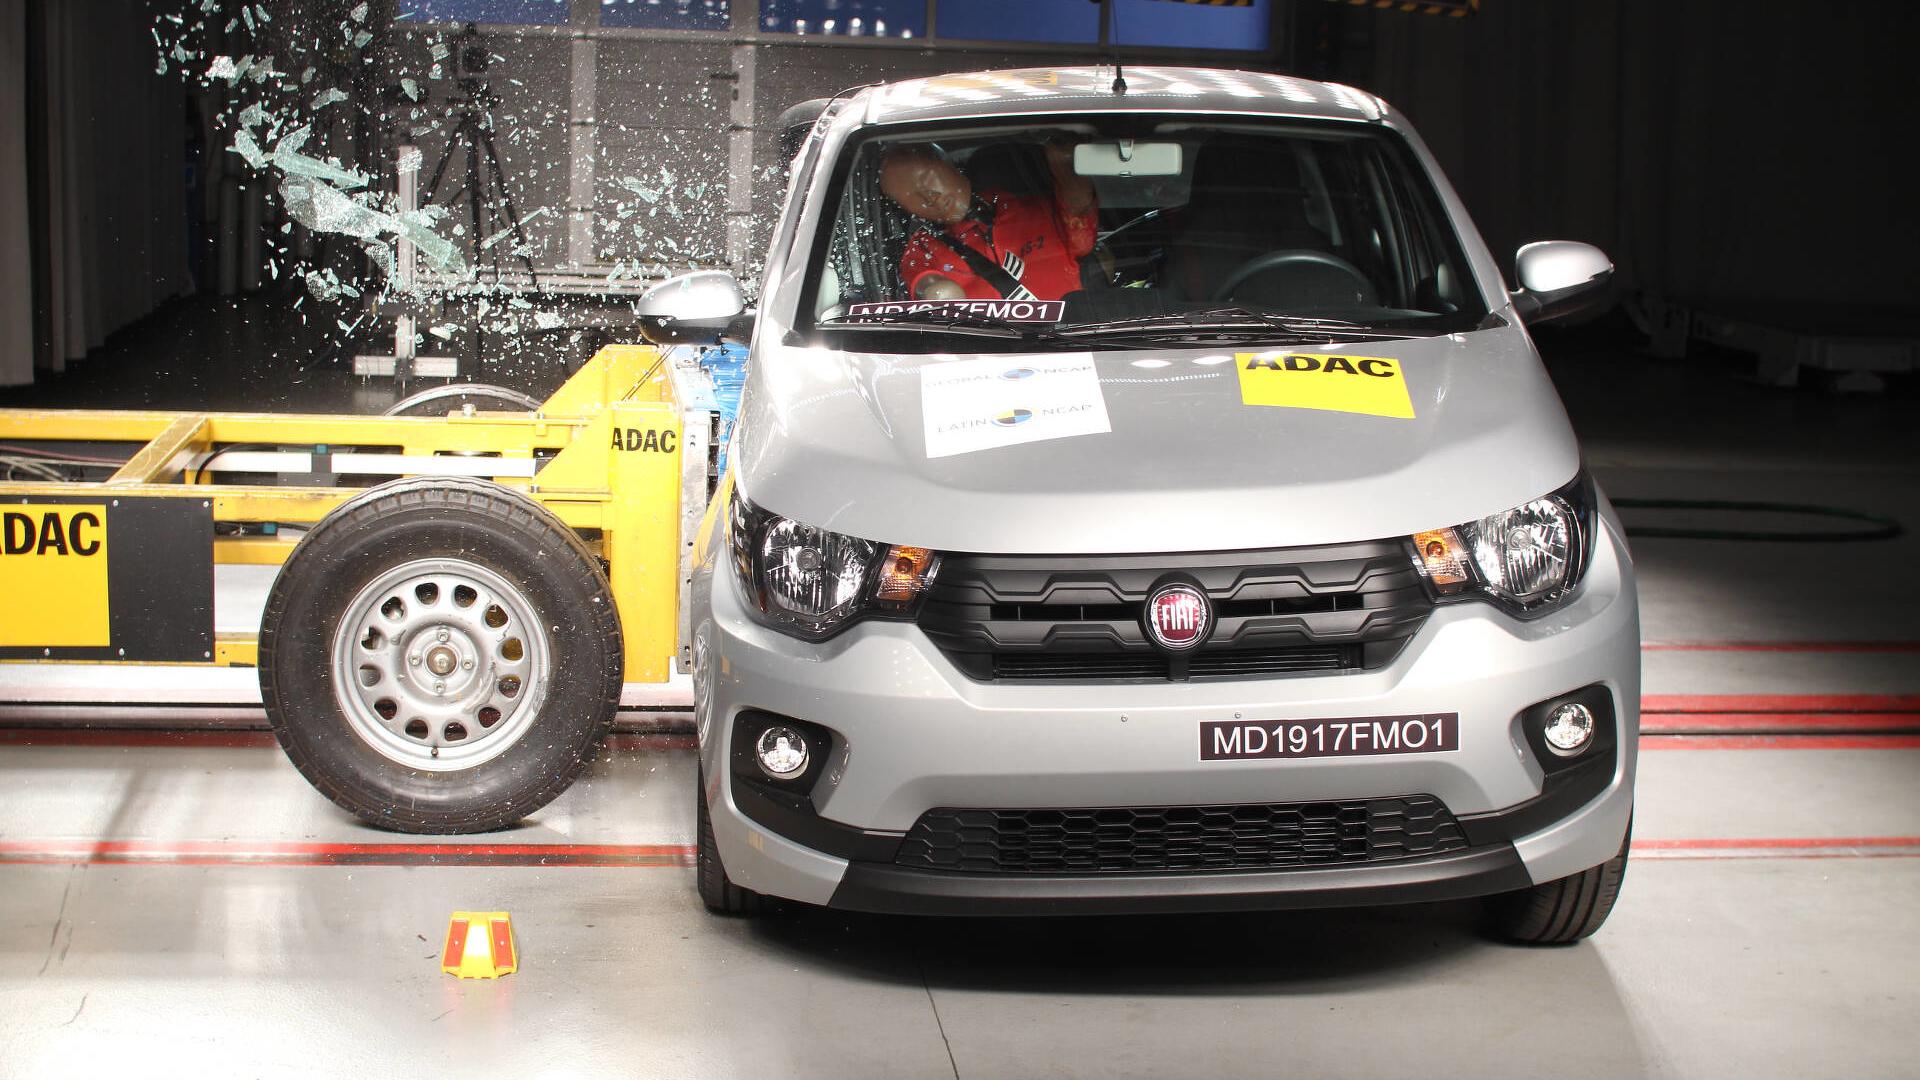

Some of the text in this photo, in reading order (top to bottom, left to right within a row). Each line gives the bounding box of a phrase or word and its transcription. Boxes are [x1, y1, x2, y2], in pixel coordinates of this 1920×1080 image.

[1043, 365, 1093, 375] NCAP
[938, 404, 1093, 433] LATIN NCAP
[611, 427, 677, 453] ADAC
[0, 512, 100, 556] DAC
[1161, 601, 1196, 630] FIAT
[1213, 718, 1443, 755] MD1917FMO1
